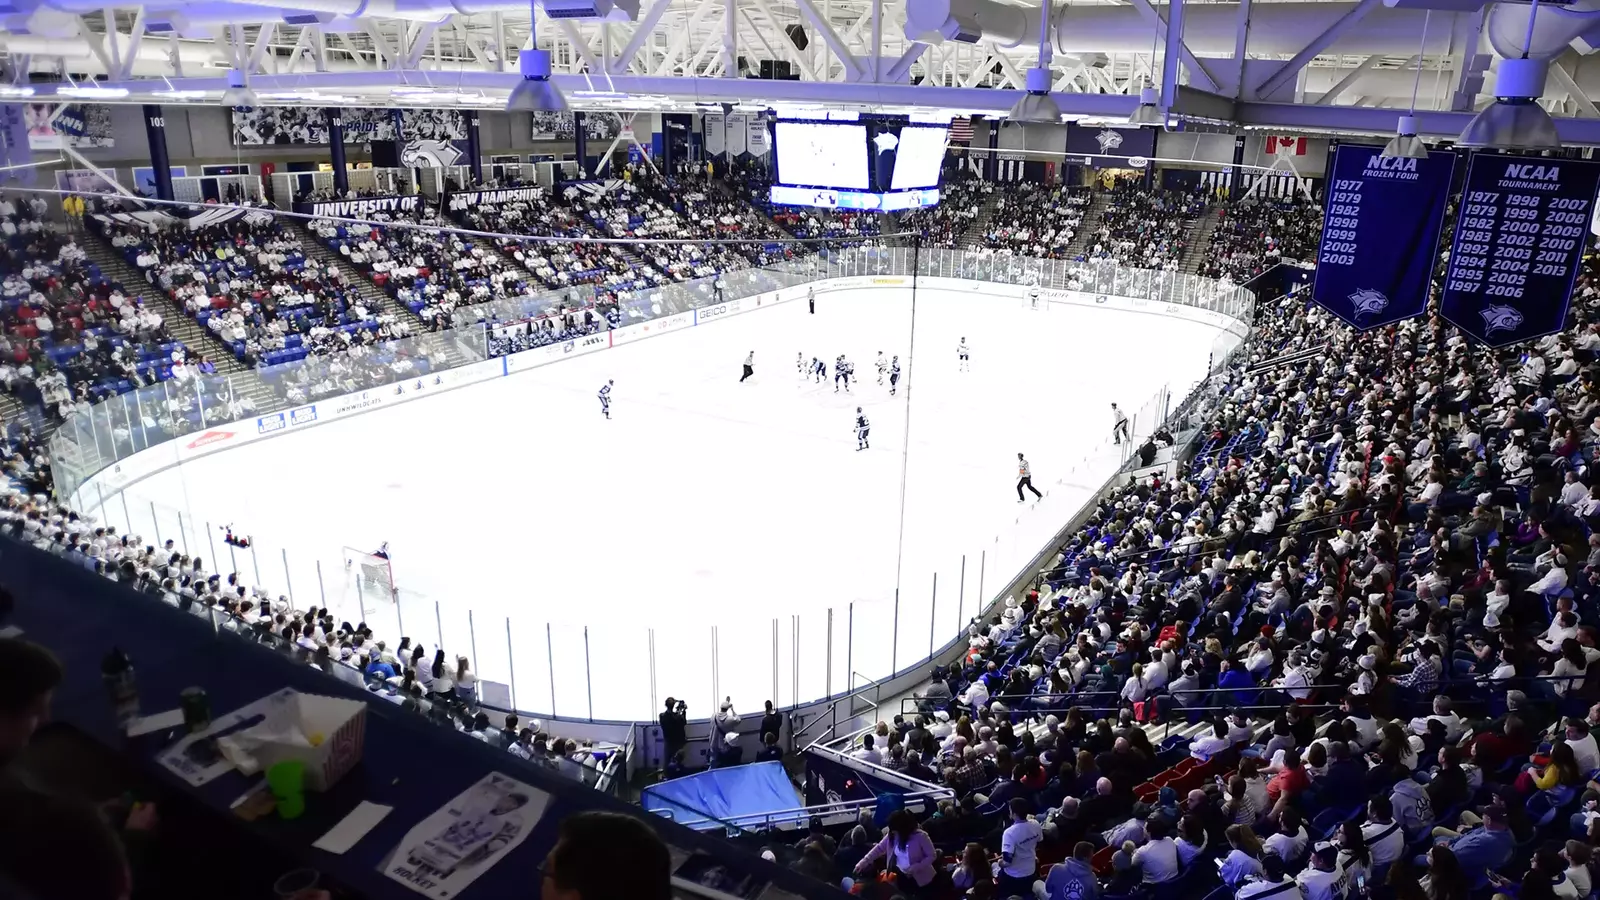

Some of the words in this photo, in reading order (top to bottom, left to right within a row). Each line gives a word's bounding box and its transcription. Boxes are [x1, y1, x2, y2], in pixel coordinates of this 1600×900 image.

[150, 117, 165, 127] 103
[344, 121, 379, 132] PRIDE
[1367, 155, 1418, 172] NCAA
[1362, 169, 1394, 178] FROZEN
[1395, 172, 1419, 180] FOUR
[1504, 163, 1560, 181] NCAA
[1334, 180, 1363, 191] 1977
[1497, 179, 1561, 191] TOURNAMENT
[481, 187, 544, 204] HAMPSHIRE
[1332, 192, 1362, 204] 1979
[1468, 191, 1499, 204] 1977
[1505, 194, 1540, 207] 1998
[1548, 197, 1588, 211] 2007
[313, 198, 398, 217] UNIVERSITY
[401, 197, 419, 211] OF
[1330, 204, 1360, 216] 1982
[1465, 204, 1498, 217] 1979
[1503, 207, 1538, 220] 1999
[1545, 211, 1586, 224] 2008
[1328, 217, 1358, 229] 1998
[1462, 217, 1495, 230] 1982
[1500, 220, 1540, 234] 2000
[1542, 224, 1583, 238] 2009
[1326, 229, 1356, 241] 1999
[1460, 229, 1492, 243] 1983
[1496, 233, 1536, 247] 2002
[1539, 237, 1576, 251] 2010
[1323, 241, 1357, 253] 2002
[1457, 242, 1490, 255] 1992
[1494, 246, 1533, 260] 2003
[1536, 250, 1568, 263] 2011
[1321, 253, 1355, 265] 2003
[1454, 255, 1487, 268] 1994
[1491, 259, 1530, 273] 2004
[1532, 263, 1567, 277] 2013
[1451, 267, 1484, 281] 1995
[1488, 272, 1527, 285] 2005
[1449, 280, 1481, 293] 1997
[1485, 284, 1525, 298] 2006
[700, 305, 727, 319] GEICO
